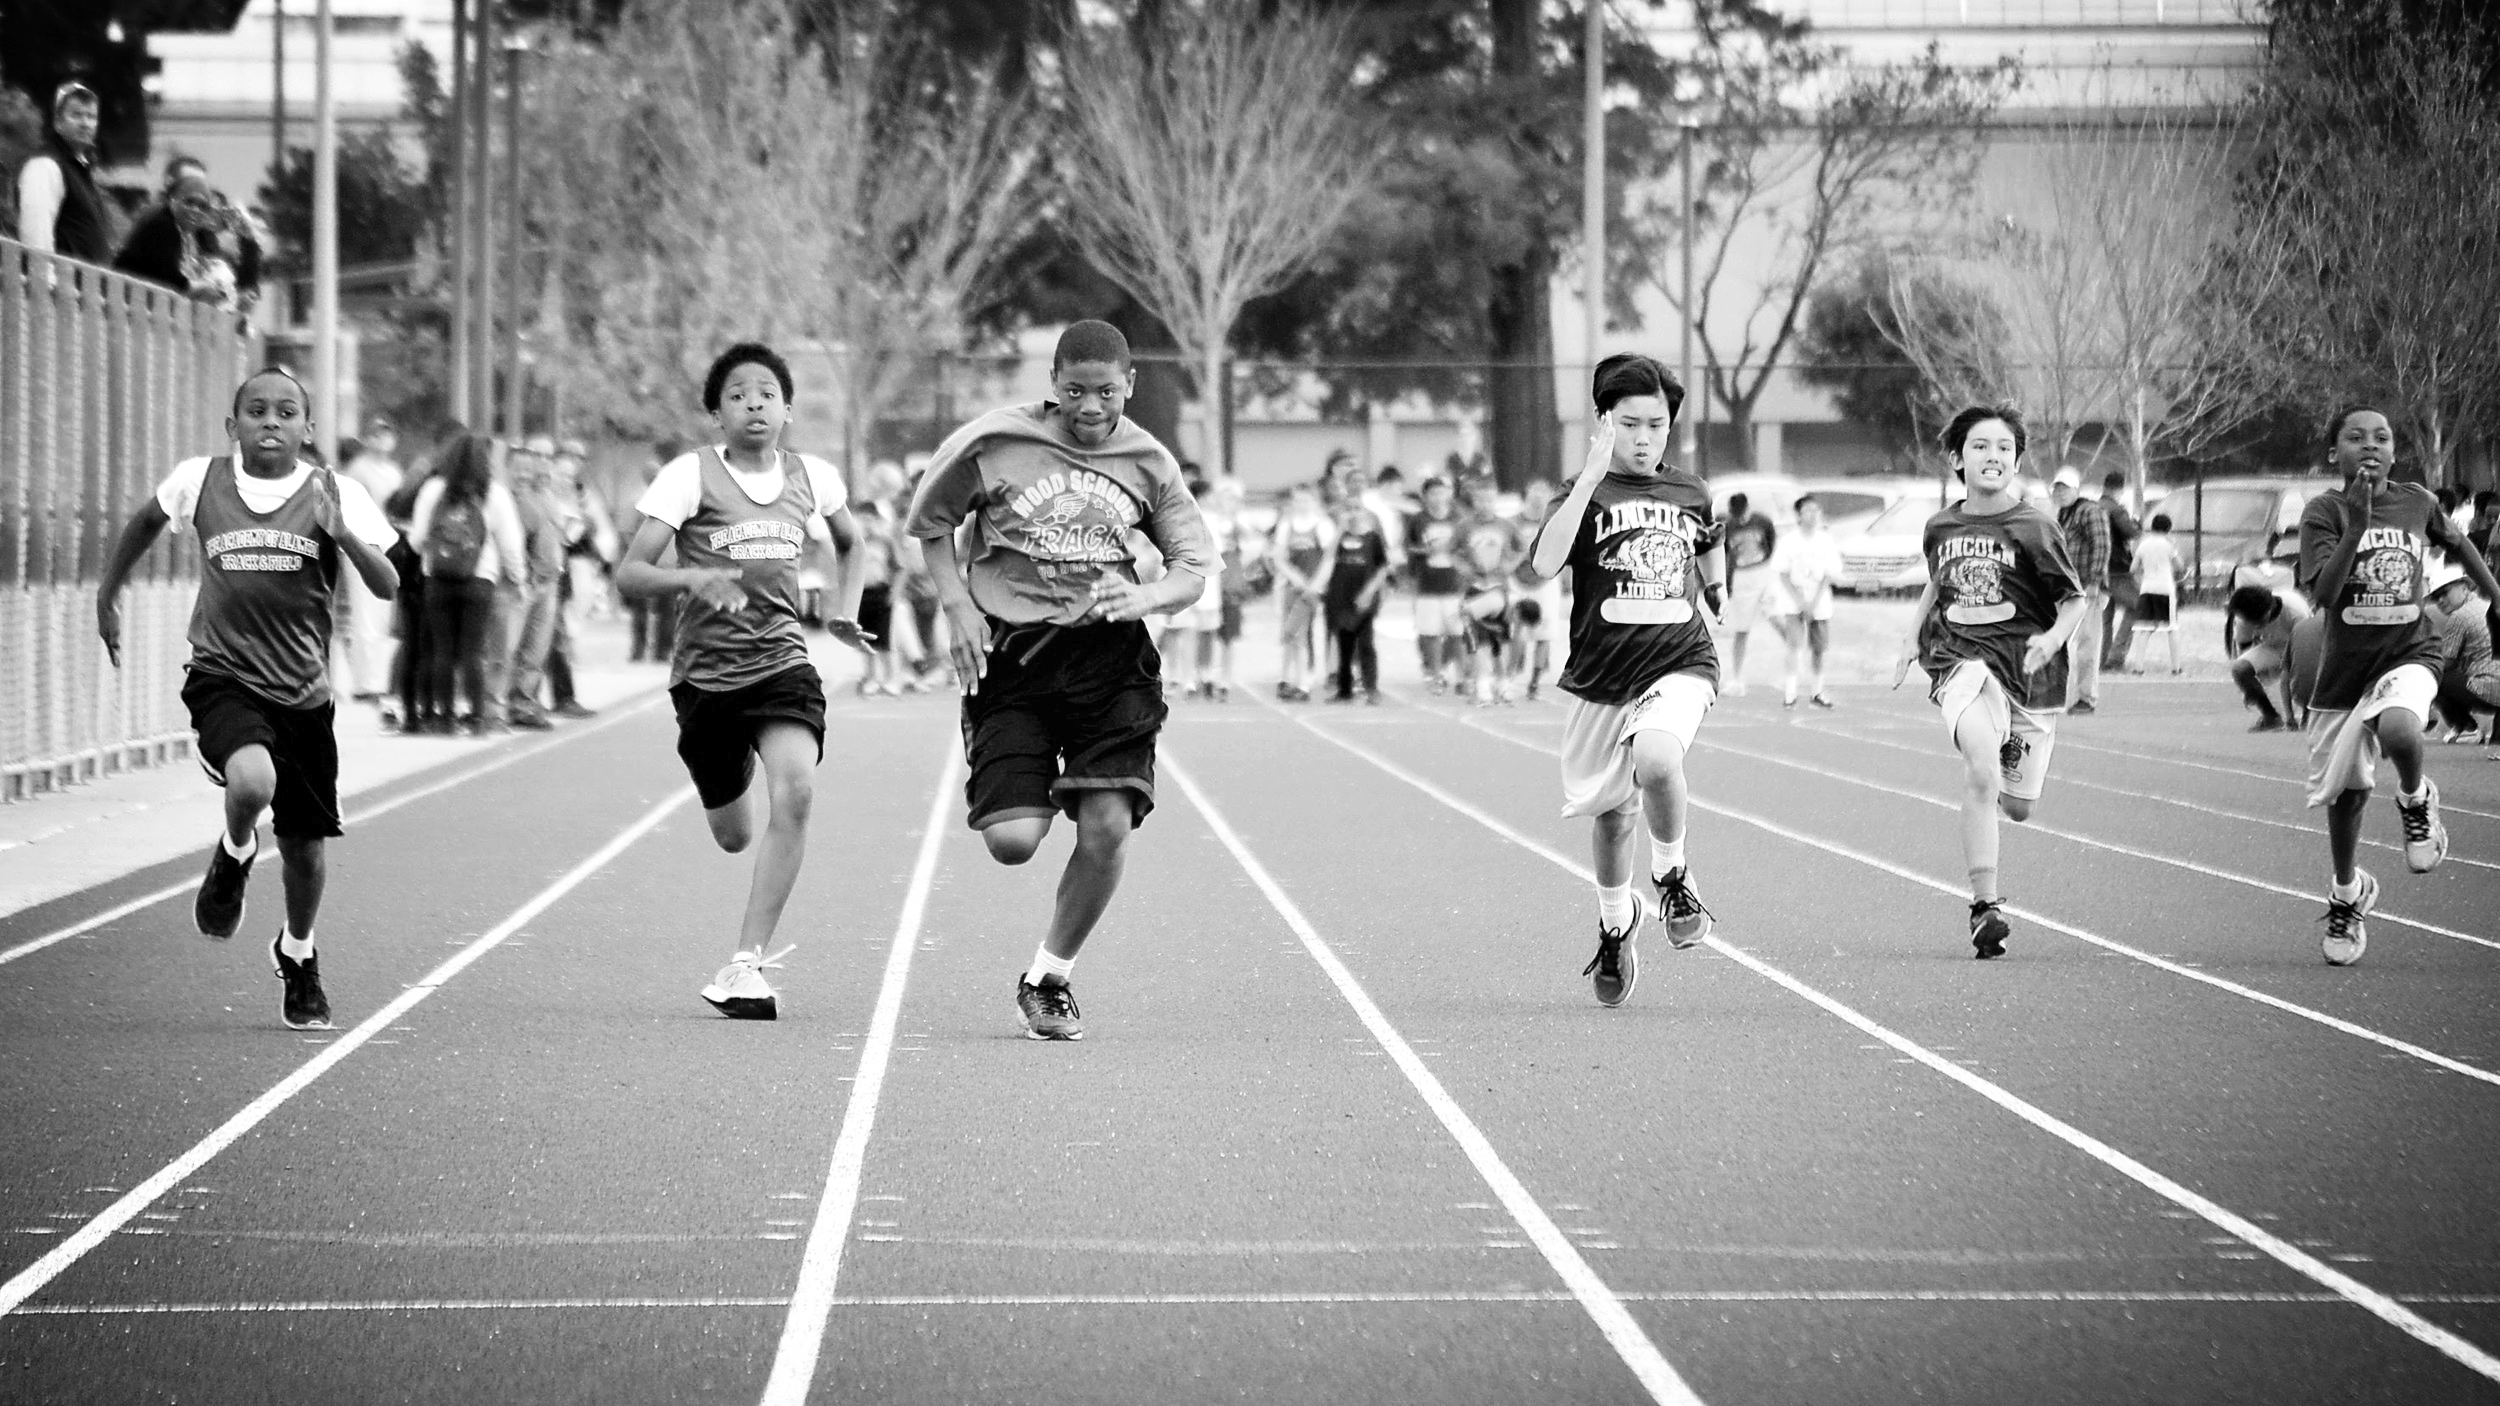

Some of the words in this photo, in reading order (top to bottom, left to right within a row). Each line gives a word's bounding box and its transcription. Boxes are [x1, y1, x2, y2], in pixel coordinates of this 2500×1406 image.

[1011, 473, 1066, 519] WOOD
[1069, 470, 1136, 522] SCHOOL
[728, 521, 769, 544] ACADEMY
[768, 520, 781, 538] OF
[1595, 501, 1697, 555] LINCOLN
[219, 528, 266, 553] ACADEMY
[264, 529, 281, 548] OF
[728, 544, 767, 560] TRACK
[2356, 527, 2422, 562] NCOLN
[220, 553, 261, 571] TRACK
[258, 554, 269, 571] &
[266, 554, 303, 571] FIELD
[1937, 536, 2016, 570] LINCOLN
[1615, 581, 1667, 600] LIONS
[2353, 593, 2395, 606] LIONS
